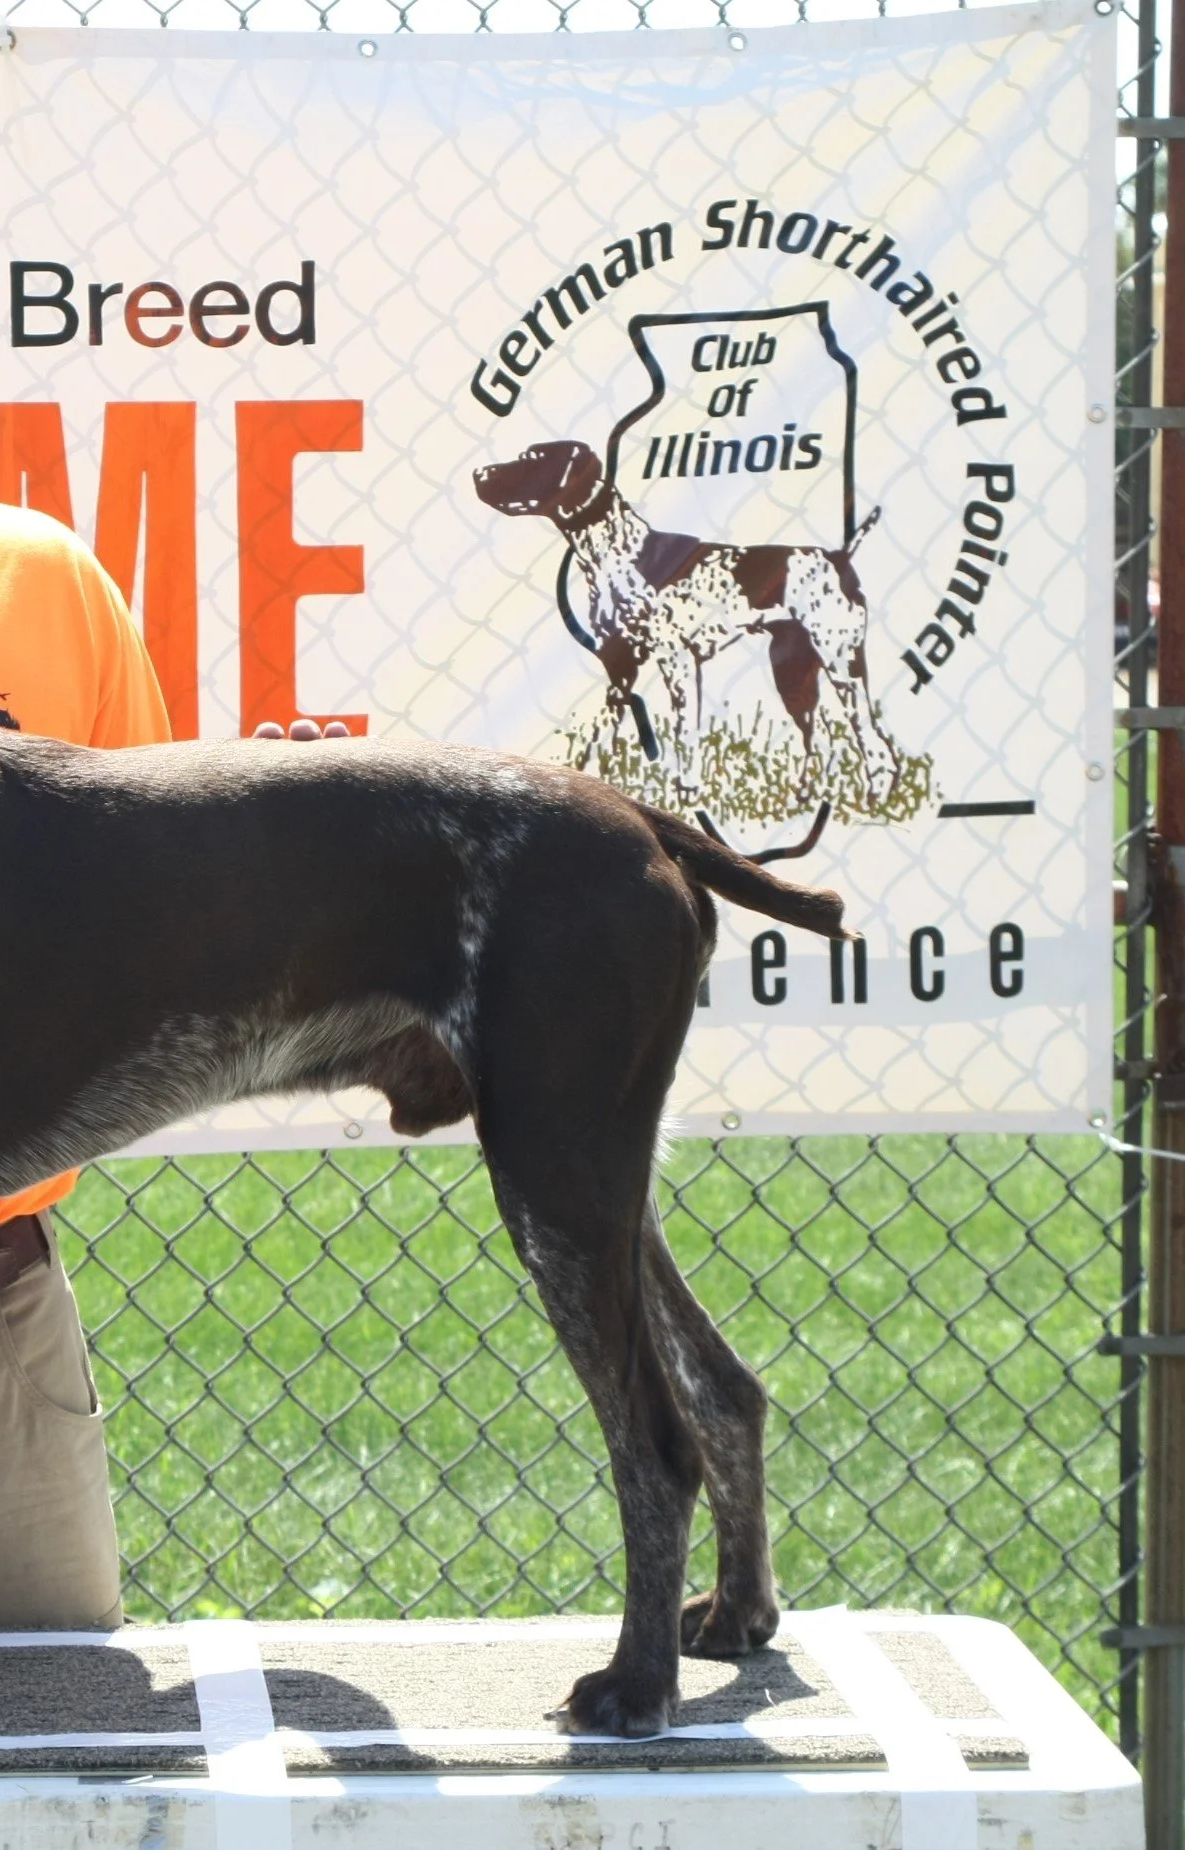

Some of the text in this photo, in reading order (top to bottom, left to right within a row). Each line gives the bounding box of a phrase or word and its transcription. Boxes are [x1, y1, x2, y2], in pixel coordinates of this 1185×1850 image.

[9, 260, 317, 349] Breed
[690, 331, 778, 374] Club
[469, 199, 1016, 696] German Shorthaired Pointer
[641, 422, 824, 480] Illinois
